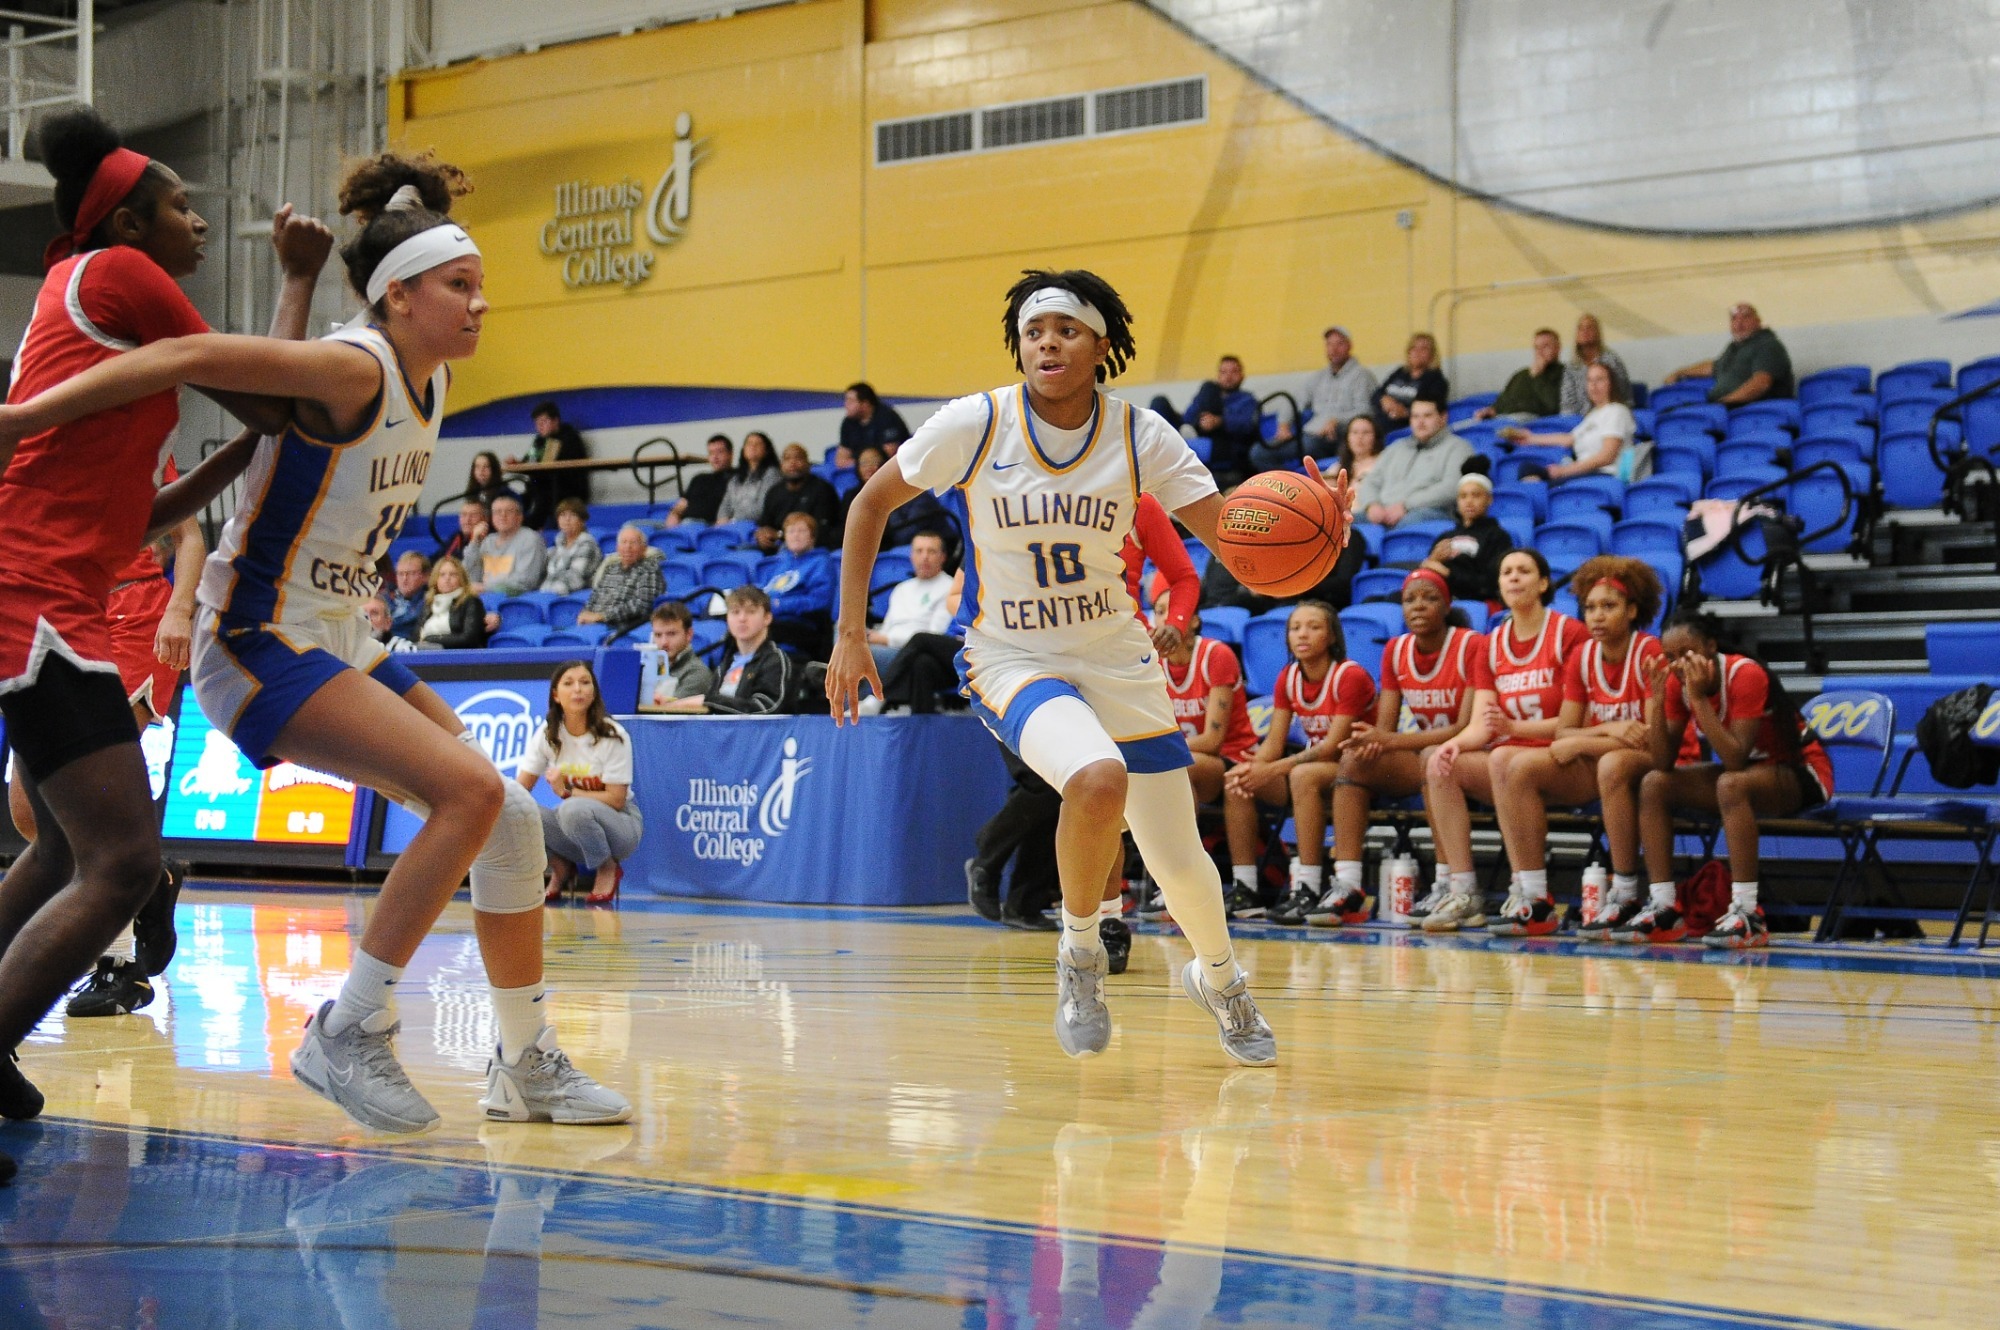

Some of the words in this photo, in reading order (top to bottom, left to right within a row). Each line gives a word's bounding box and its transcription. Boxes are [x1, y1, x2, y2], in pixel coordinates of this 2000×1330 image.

[555, 175, 643, 217] Illinois
[540, 209, 633, 255] Central
[563, 247, 654, 288] College
[993, 493, 1118, 532] ILLINOIS
[1220, 508, 1281, 526] LEGACY
[1028, 542, 1086, 588] 10
[1505, 693, 1543, 721] 15
[688, 778, 759, 807] Illinois
[675, 804, 750, 833] Central
[693, 831, 765, 867] College
